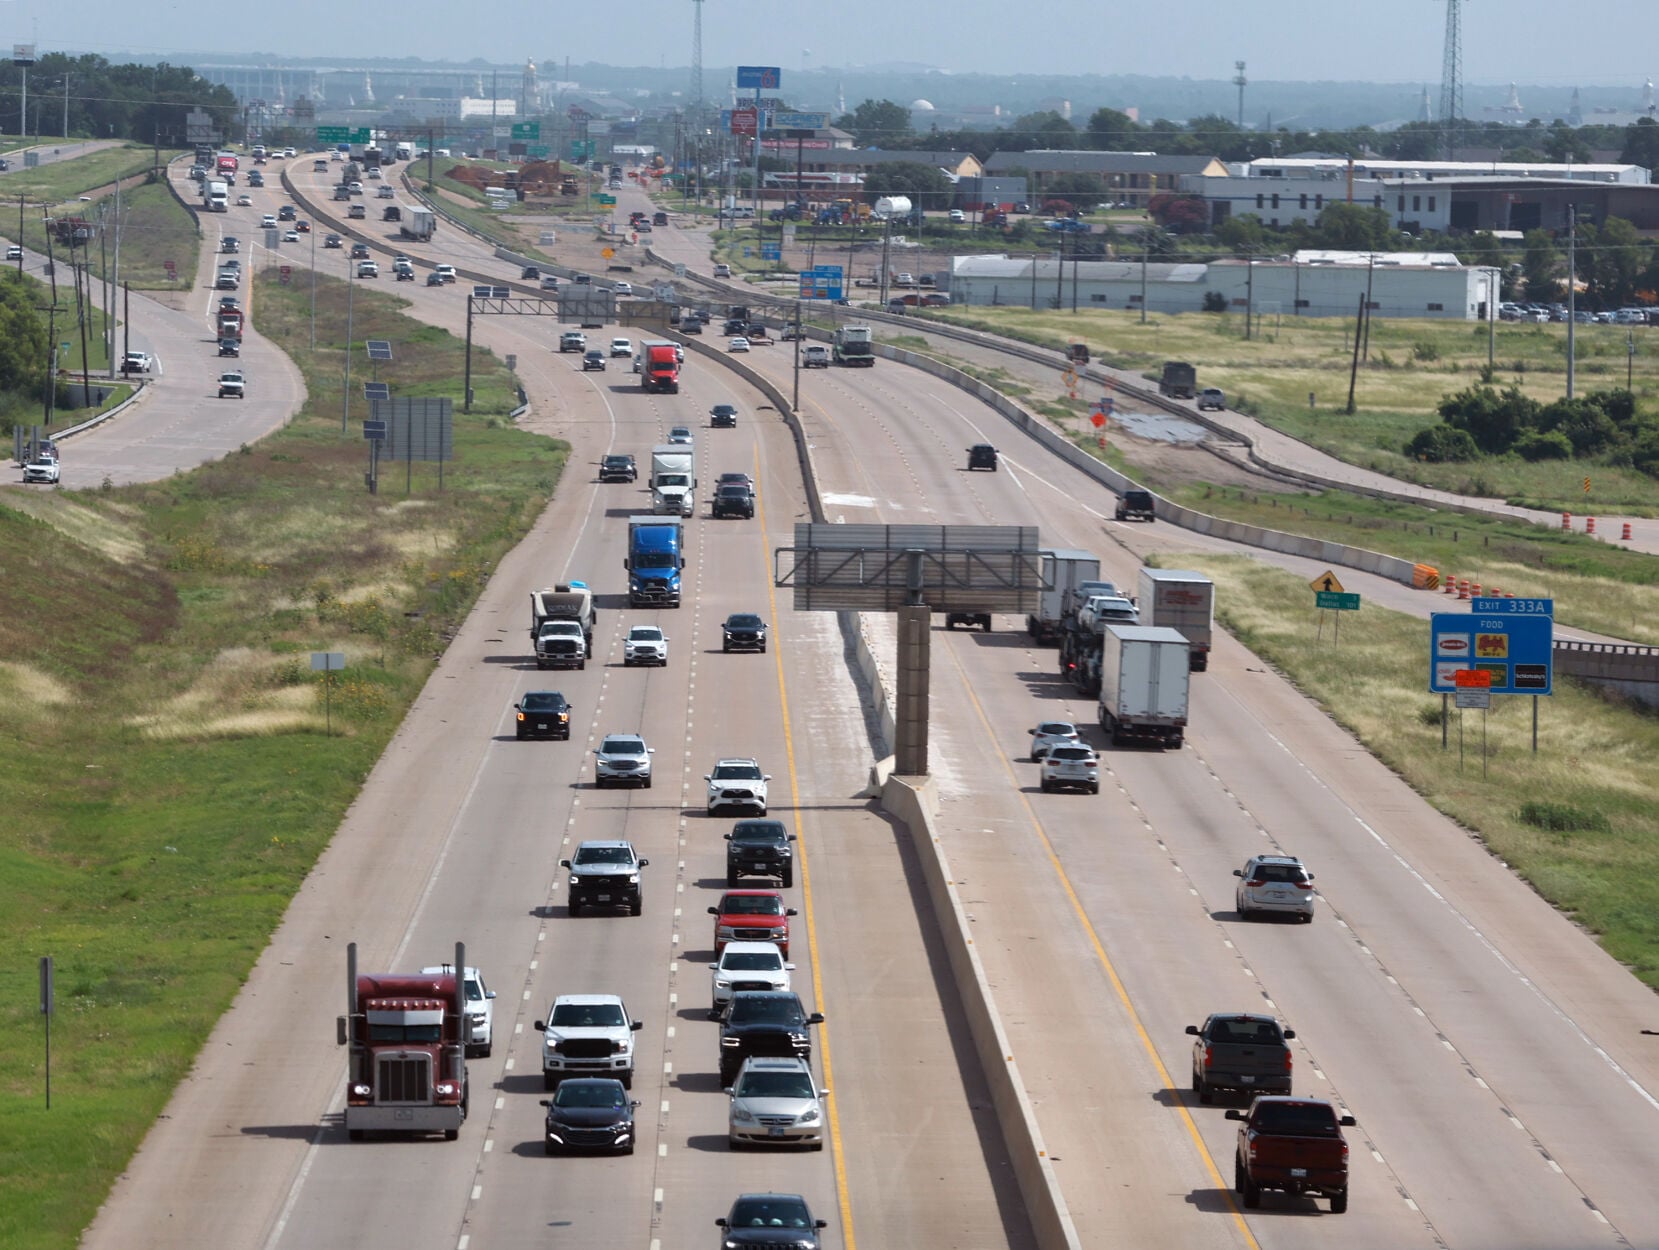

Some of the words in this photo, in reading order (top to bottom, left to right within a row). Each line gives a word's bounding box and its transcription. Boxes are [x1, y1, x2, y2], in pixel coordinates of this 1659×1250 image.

[761, 69, 776, 88] 6
[1479, 601, 1500, 610] EXIT
[1509, 600, 1545, 612] 333A
[1480, 620, 1504, 629] FOOD
